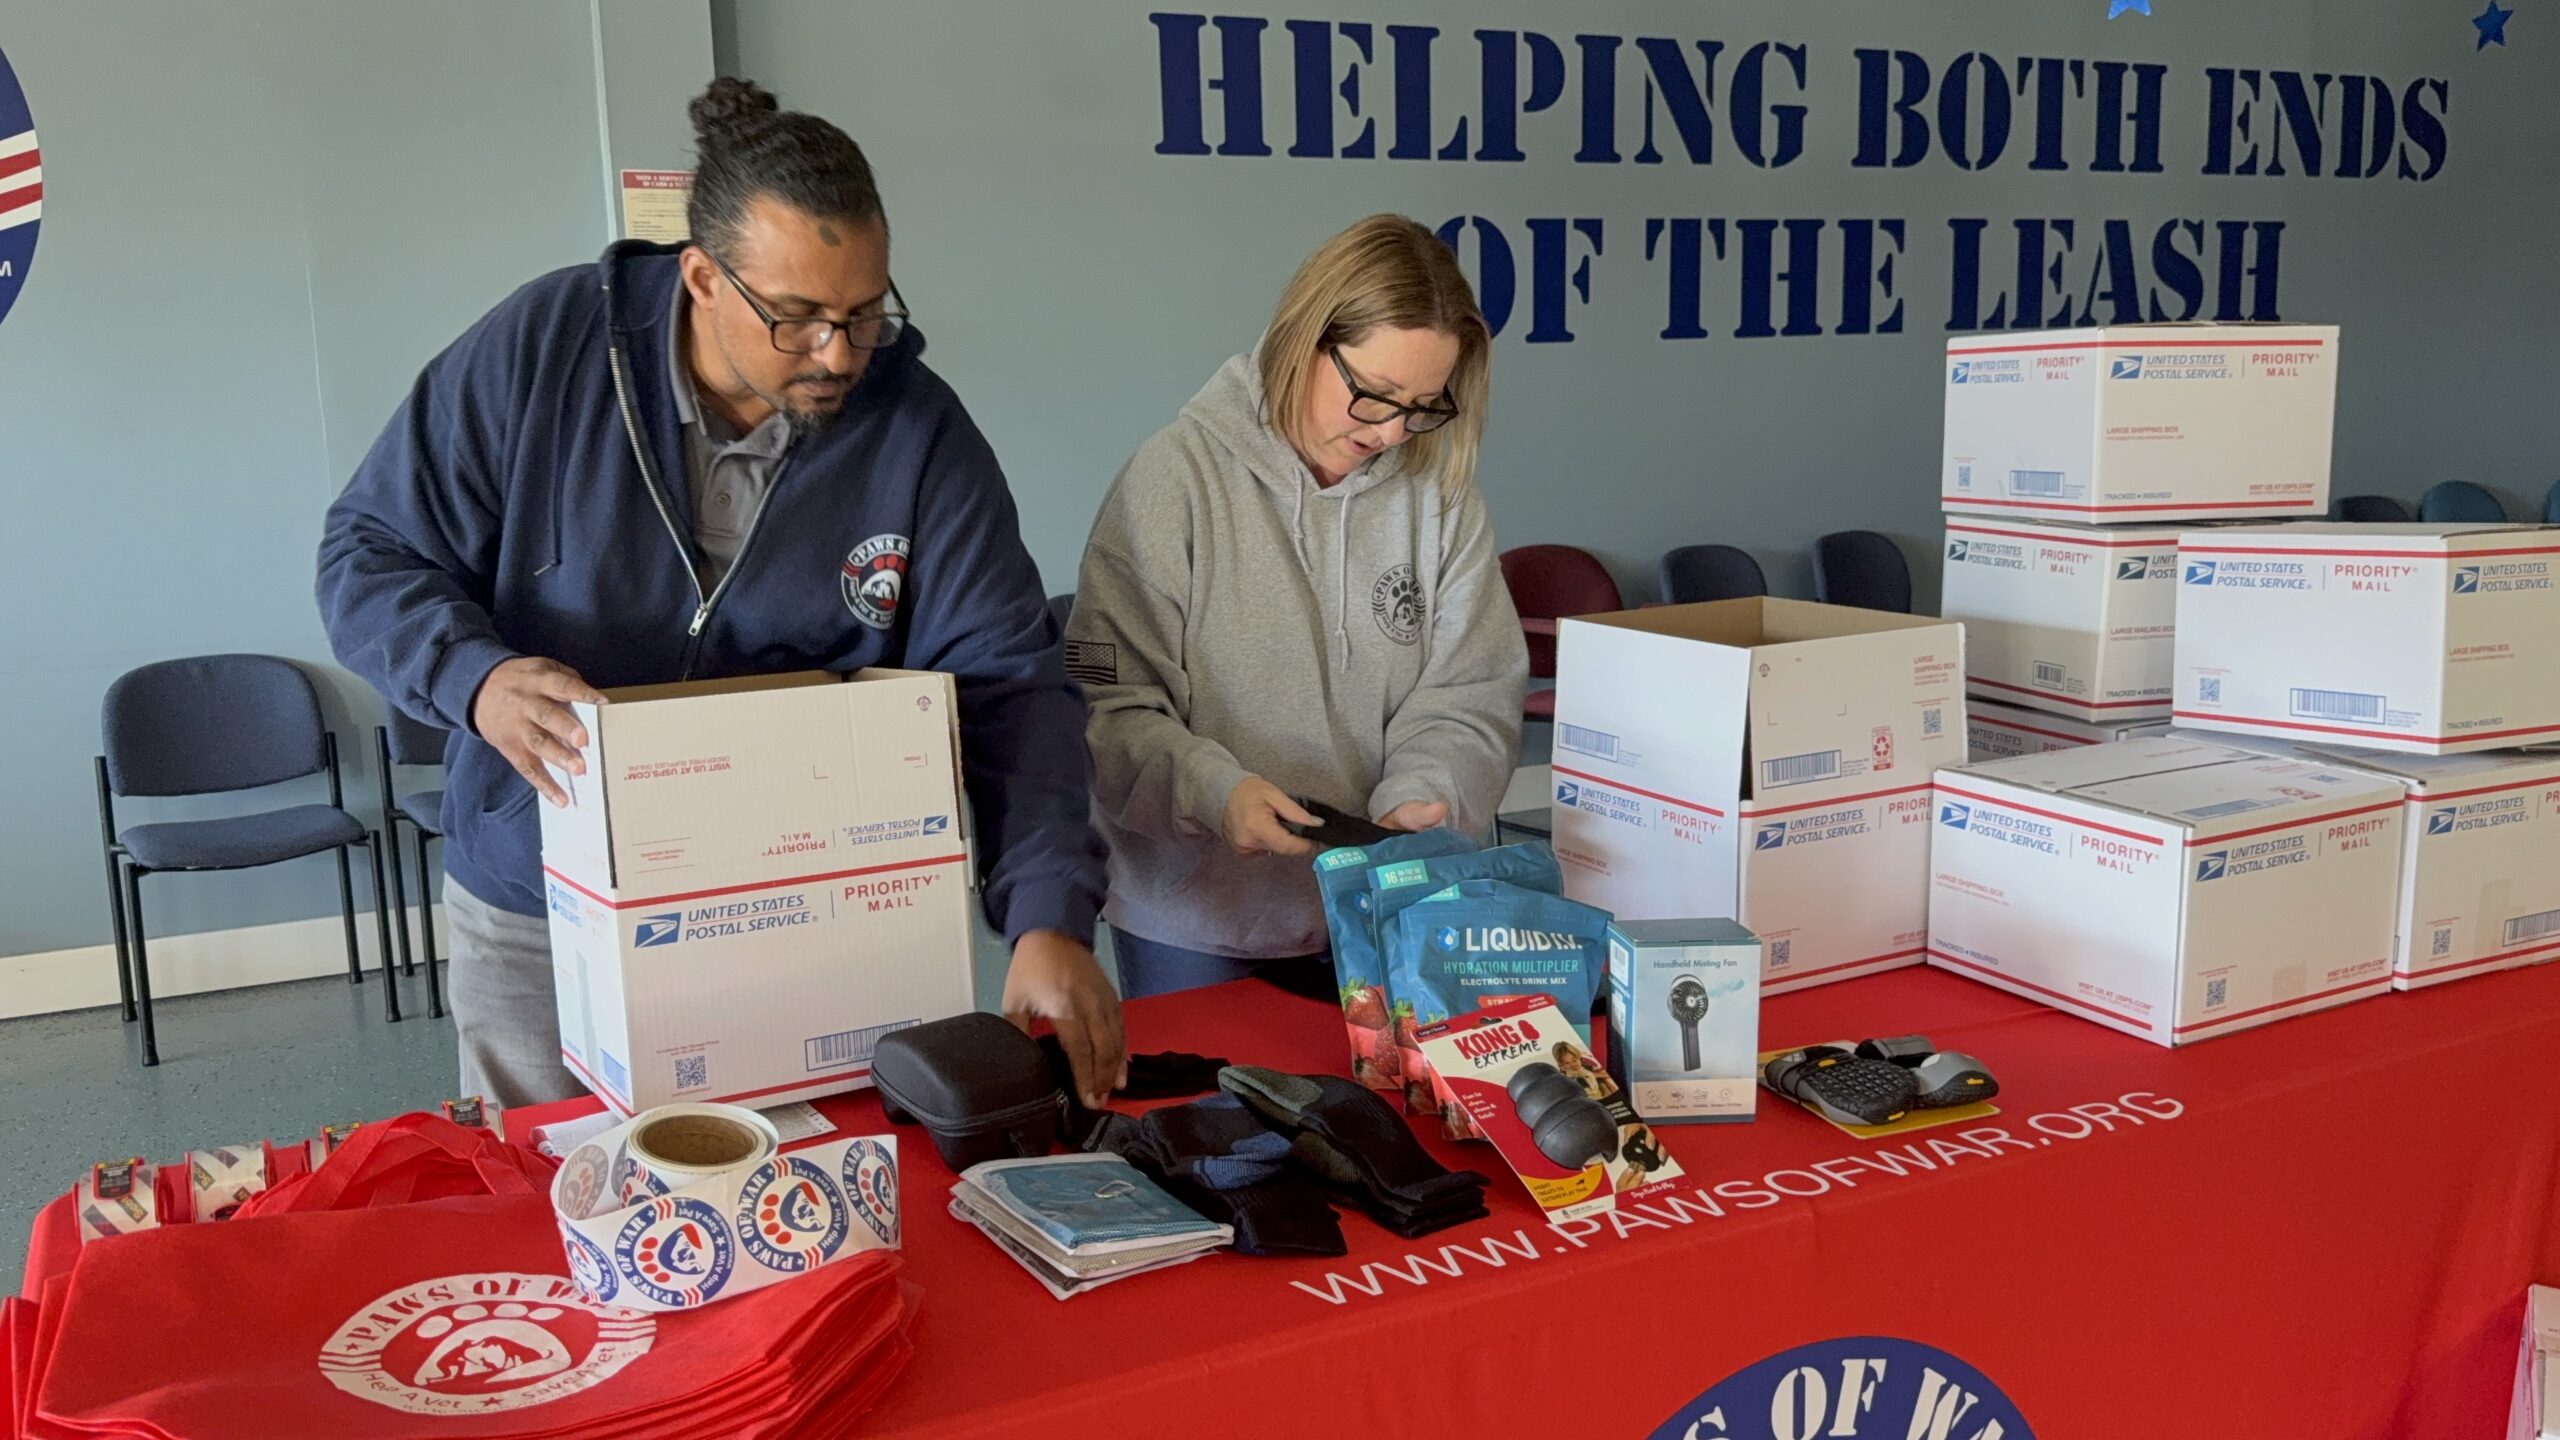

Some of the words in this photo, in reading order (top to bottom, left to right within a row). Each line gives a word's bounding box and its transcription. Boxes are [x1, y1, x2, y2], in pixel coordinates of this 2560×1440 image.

[1149, 13, 1808, 168] HELPING
[1851, 49, 2168, 171] BOTH
[2201, 67, 2450, 182] ENDS
[1435, 215, 1603, 342] OF
[1645, 218, 1905, 338] THE
[1944, 217, 2286, 330] LEASH
[1972, 361, 1996, 370] UNITED
[1997, 360, 2020, 368] STATES
[2036, 356, 2080, 368] PRIORITY
[2146, 355, 2187, 365] UNITED
[2188, 354, 2226, 364] STATES
[2252, 353, 2316, 364] PRIORITY
[1970, 374, 1992, 384] POSTAL
[1993, 372, 2021, 382] SERVICE
[2046, 371, 2070, 380] MAIL
[2143, 370, 2184, 380] POSTAL
[2185, 368, 2227, 378] SERVICE
[2266, 367, 2299, 377] MAIL
[1970, 541, 1997, 553] UNITED
[1998, 544, 2023, 556] STATES
[2040, 548, 2088, 564] PRIORITY
[1967, 554, 1992, 567] POSTAL
[1993, 557, 2023, 570] SERVICE
[2050, 563, 2075, 575] MAIL
[2220, 562, 2263, 574] UNITED
[2264, 562, 2303, 574] STATES
[2334, 564, 2412, 578] PRIORITY
[2483, 564, 2517, 576] UNITED
[2518, 562, 2548, 574] STATES
[1376, 569, 1400, 596] PAWS
[2217, 577, 2257, 588] POSTAL
[2258, 578, 2306, 590] SERVICE
[2352, 581, 2392, 592] MAIL
[2480, 580, 2514, 592] POSTAL
[2514, 578, 2550, 590] SERVICE
[1914, 656, 1934, 664] LARGE
[1944, 662, 1956, 671] BOX
[1581, 786, 1612, 803] UNITED
[1612, 794, 1640, 812] STATES
[2460, 802, 2494, 816] UNITED
[2494, 797, 2524, 811] STATES
[1579, 800, 1609, 816] POSTAL
[1610, 808, 1642, 826] SERVICE
[1662, 809, 1717, 834] PRIORITY
[1789, 814, 1828, 830] UNITED
[1828, 808, 1864, 823] STATES
[2455, 817, 2490, 832] POSTAL
[2490, 811, 2526, 826] SERVICE
[848, 821, 886, 834] SERVICE
[886, 818, 922, 830] POSTAL
[1974, 808, 2014, 827] UNITED
[2014, 818, 2054, 838] STATES
[2328, 818, 2386, 840] PRIORITY
[780, 832, 812, 842] MAIL
[851, 832, 884, 846] STATES
[885, 829, 920, 843] UNITED
[1674, 828, 1703, 844] MAIL
[1787, 831, 1825, 846] POSTAL
[1826, 823, 1866, 839] SERVICE
[1970, 823, 2008, 842] POSTAL
[2010, 834, 2054, 854] SERVICE
[766, 840, 826, 856] PRIORITY
[2081, 835, 2153, 864] PRIORITY
[2231, 842, 2269, 860] UNITED
[2269, 835, 2304, 852] STATES
[2341, 838, 2370, 852] MAIL
[2096, 856, 2134, 874] MAIL
[2228, 858, 2264, 876] POSTAL
[2266, 850, 2306, 869] SERVICE
[844, 874, 934, 900] PRIORITY
[1384, 872, 1398, 884] 16
[688, 902, 748, 923] UNITED
[750, 894, 806, 913] STATES
[867, 896, 914, 912] MAIL
[685, 922, 745, 941] POSTAL
[748, 911, 811, 932] SERVICE
[1466, 928, 1551, 952] LIQUID
[1444, 960, 1508, 974] HYDRATION
[1512, 959, 1579, 973] MULTIPLIER
[1653, 960, 1690, 968] Handheld
[1693, 960, 1720, 969] Misting
[1460, 978, 1520, 986] ELECTROLYTE
[1453, 1024, 1522, 1060] KONG
[1474, 1040, 1541, 1068] EXTREME
[1462, 1092, 1474, 1100] Fun
[844, 1148, 861, 1176] WAR
[740, 1174, 768, 1209] WAR
[845, 1181, 860, 1202] OF
[1287, 1088, 2184, 1308] WWW.PAWSOFWAR.ORG
[678, 1208, 694, 1216] Pet
[702, 1214, 720, 1234] Save
[858, 1204, 887, 1240] PAWS
[616, 1216, 646, 1250] WAR
[821, 1230, 838, 1248] Help
[618, 1254, 634, 1272] OF
[748, 1240, 793, 1270] PAWS
[701, 1274, 720, 1291] Help
[714, 1266, 724, 1274] A
[719, 1250, 727, 1266] Vet
[628, 1276, 673, 1304] PAWS
[346, 1284, 455, 1342] PAWS
[473, 1278, 532, 1296] OF
[522, 1375, 578, 1400] Save
[1770, 1358, 1887, 1440] OF
